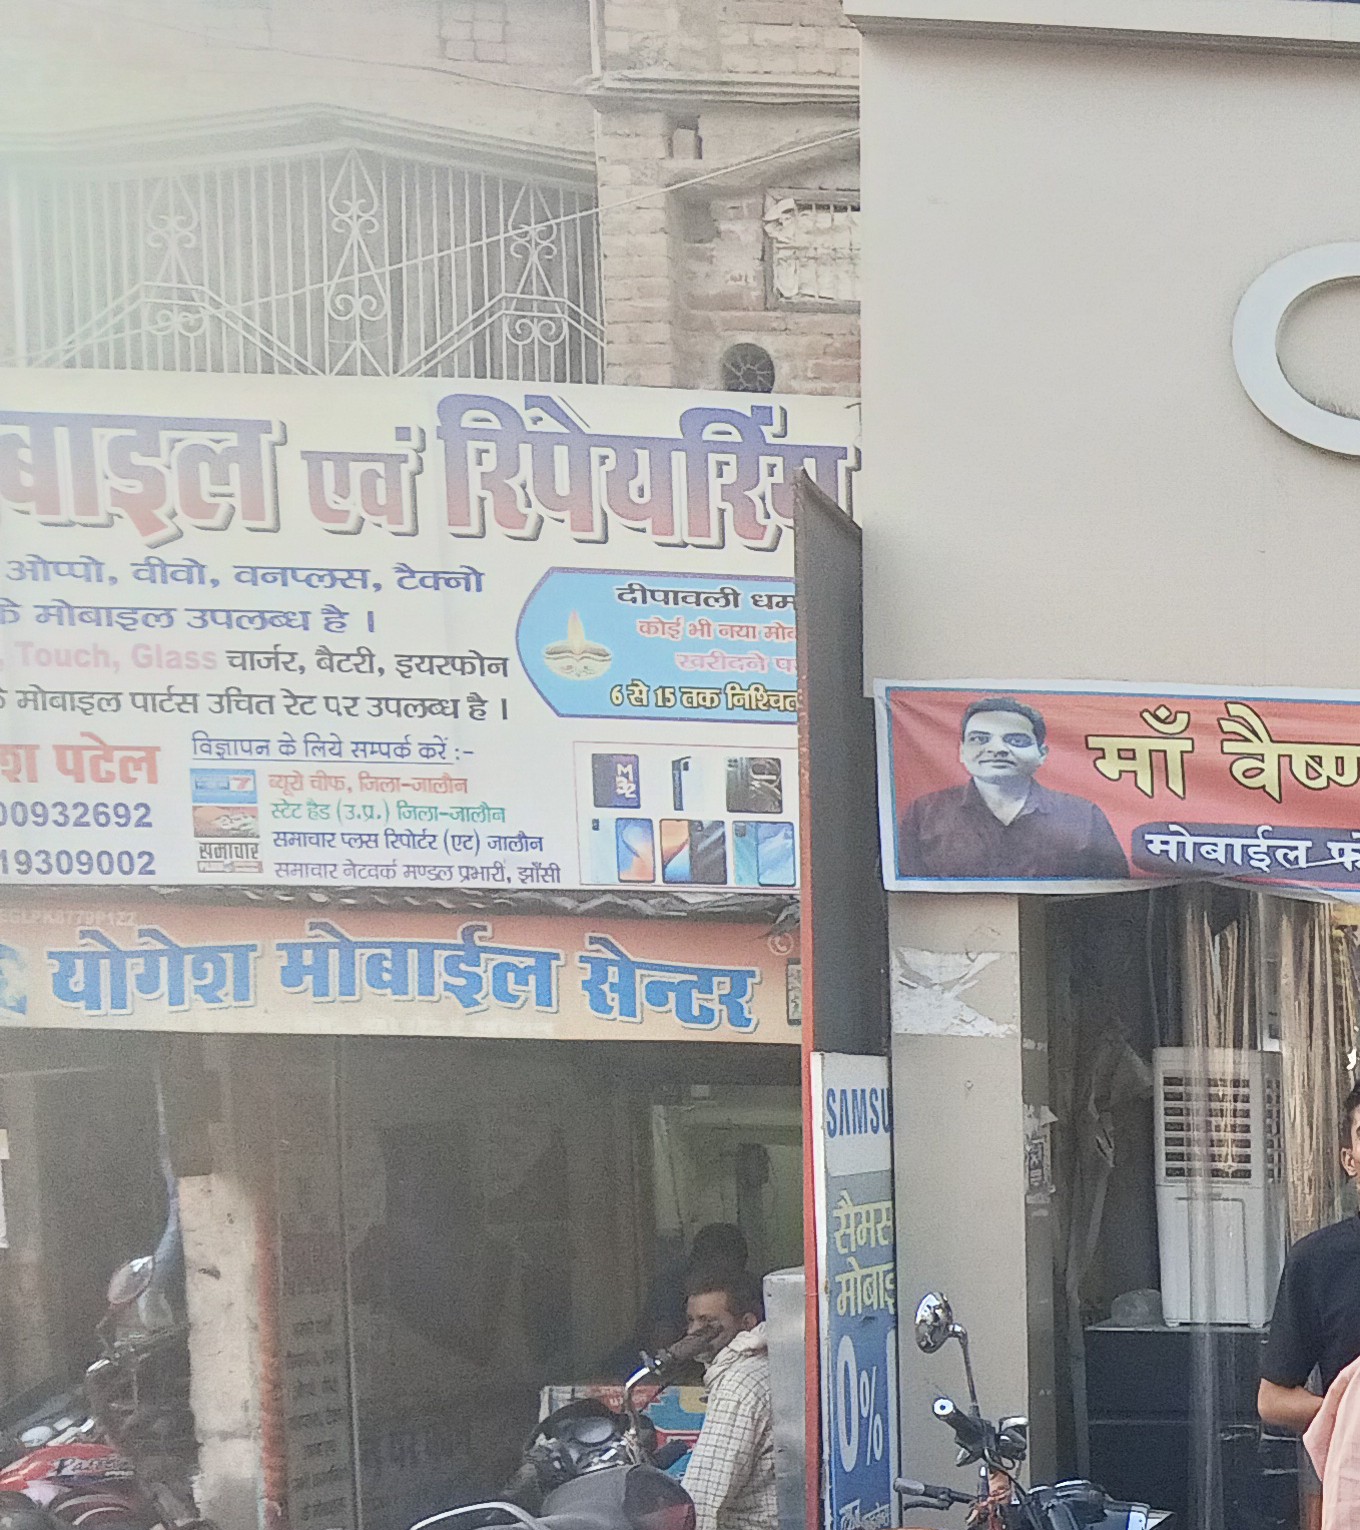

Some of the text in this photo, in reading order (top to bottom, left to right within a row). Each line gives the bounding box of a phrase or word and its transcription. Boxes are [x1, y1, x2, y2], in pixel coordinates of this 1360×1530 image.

[0, 411, 286, 548] बाइल
[300, 426, 425, 536] एवं
[6, 554, 118, 586] ओप्पो,
[130, 556, 220, 588] वीवो,
[233, 566, 382, 592] वनप्लस,
[614, 582, 741, 609] दीपावली
[33, 599, 349, 633] मोबाइल उपलब्ध है
[637, 617, 757, 640] कोई भी नया
[15, 641, 217, 674] Touch, Glass
[226, 644, 509, 678] चार्जर, बैटरी, इयरफोन
[16, 684, 123, 716] मोबाइल
[206, 686, 276, 715] उचित
[280, 688, 317, 716] रेट
[323, 697, 360, 717] पर
[366, 697, 460, 719] उपलब्ध
[467, 692, 488, 721] है
[610, 684, 622, 706] 6
[627, 679, 648, 705] से
[655, 687, 676, 706] 15
[680, 687, 720, 709] तक
[52, 731, 161, 784] पटेल
[192, 730, 270, 759] विज्ञापन
[277, 732, 298, 757] के
[303, 732, 343, 758] लिये
[350, 735, 412, 760] सम्पर्क
[1087, 705, 1194, 797] माँ
[272, 831, 337, 849] समाचार
[1145, 824, 1311, 871] मोबाईल
[47, 919, 763, 1034] योगेश मोबाईल सेन्टर
[825, 1086, 892, 1139] SAMSU
[834, 1191, 893, 1254] सैमस
[835, 1256, 895, 1317] मोबाइ
